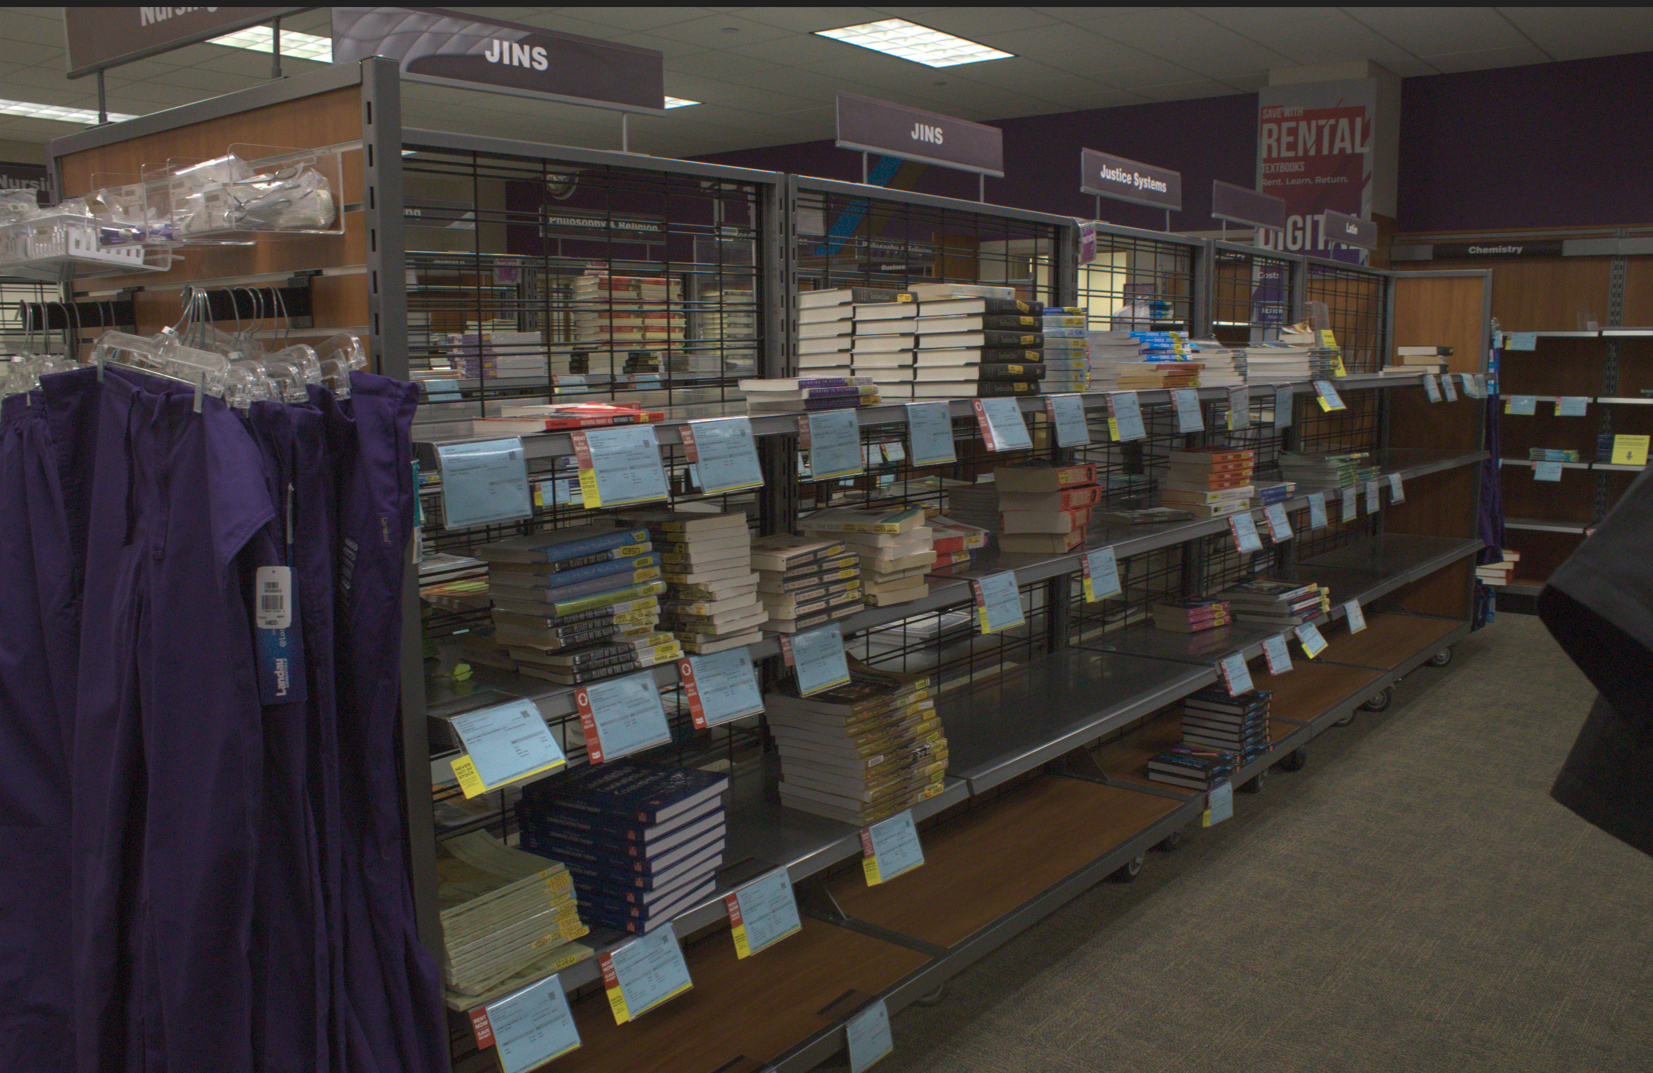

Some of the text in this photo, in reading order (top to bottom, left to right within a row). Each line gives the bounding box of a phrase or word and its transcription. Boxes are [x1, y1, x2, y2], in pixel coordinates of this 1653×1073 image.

[485, 38, 549, 71] JINS
[1263, 106, 1303, 119] SAVE WITH
[911, 123, 944, 145] JINS
[1261, 116, 1371, 159] RENTAL
[1262, 161, 1305, 173] TEXTBOOKS
[1100, 164, 1167, 193] Justice Systems
[1262, 175, 1349, 187] Rent. Learn. Return.
[1468, 244, 1523, 256] Chemistry
[622, 547, 640, 555] USED
[274, 658, 287, 697] Landau
[455, 762, 471, 772] NEVER
[459, 770, 475, 780] STOCK
[561, 916, 577, 926] USED
[555, 955, 575, 968] USED
[473, 1014, 486, 1024] RENT
[475, 1020, 488, 1029] NOW
[477, 1028, 490, 1037] SAVE
